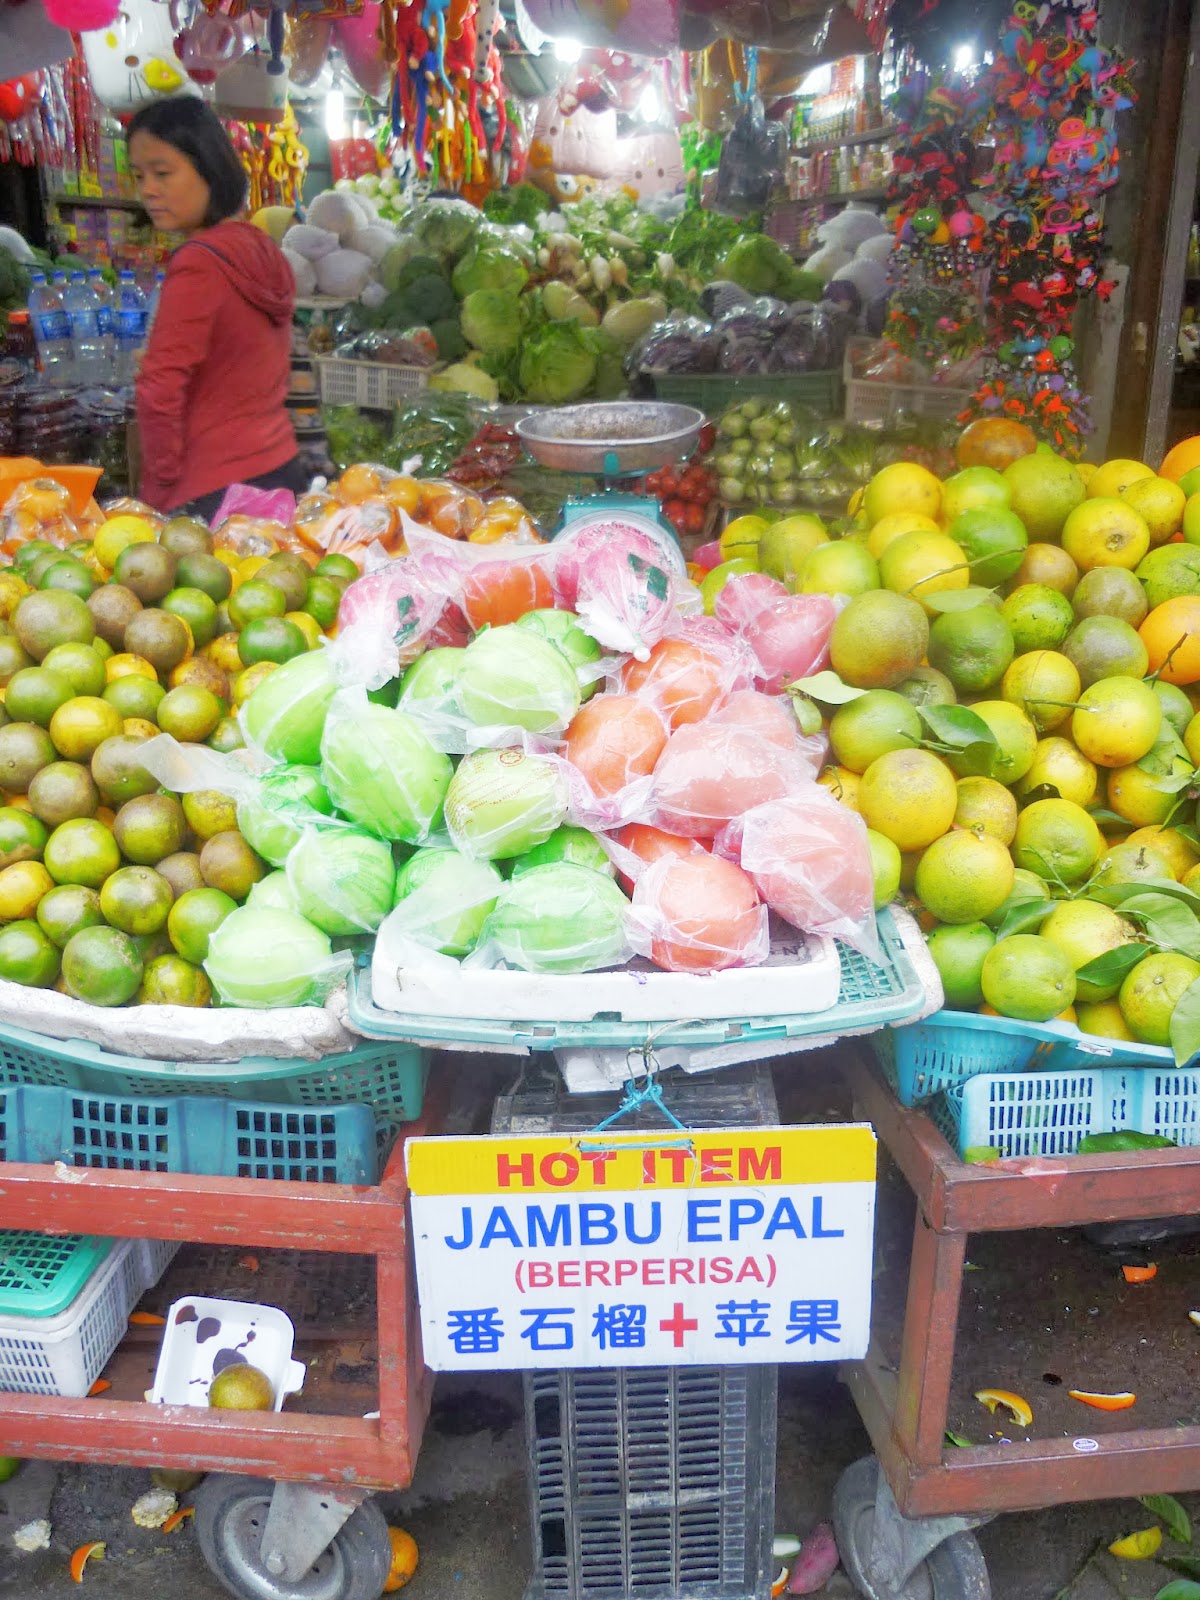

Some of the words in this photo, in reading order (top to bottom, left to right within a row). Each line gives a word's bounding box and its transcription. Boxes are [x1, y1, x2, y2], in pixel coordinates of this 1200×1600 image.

[497, 1152, 617, 1187] HOT
[643, 1146, 782, 1184] ITEM
[444, 1200, 661, 1250] JAMBU
[687, 1196, 845, 1243] EPAL
[515, 1254, 777, 1293] (BERPERISA)
